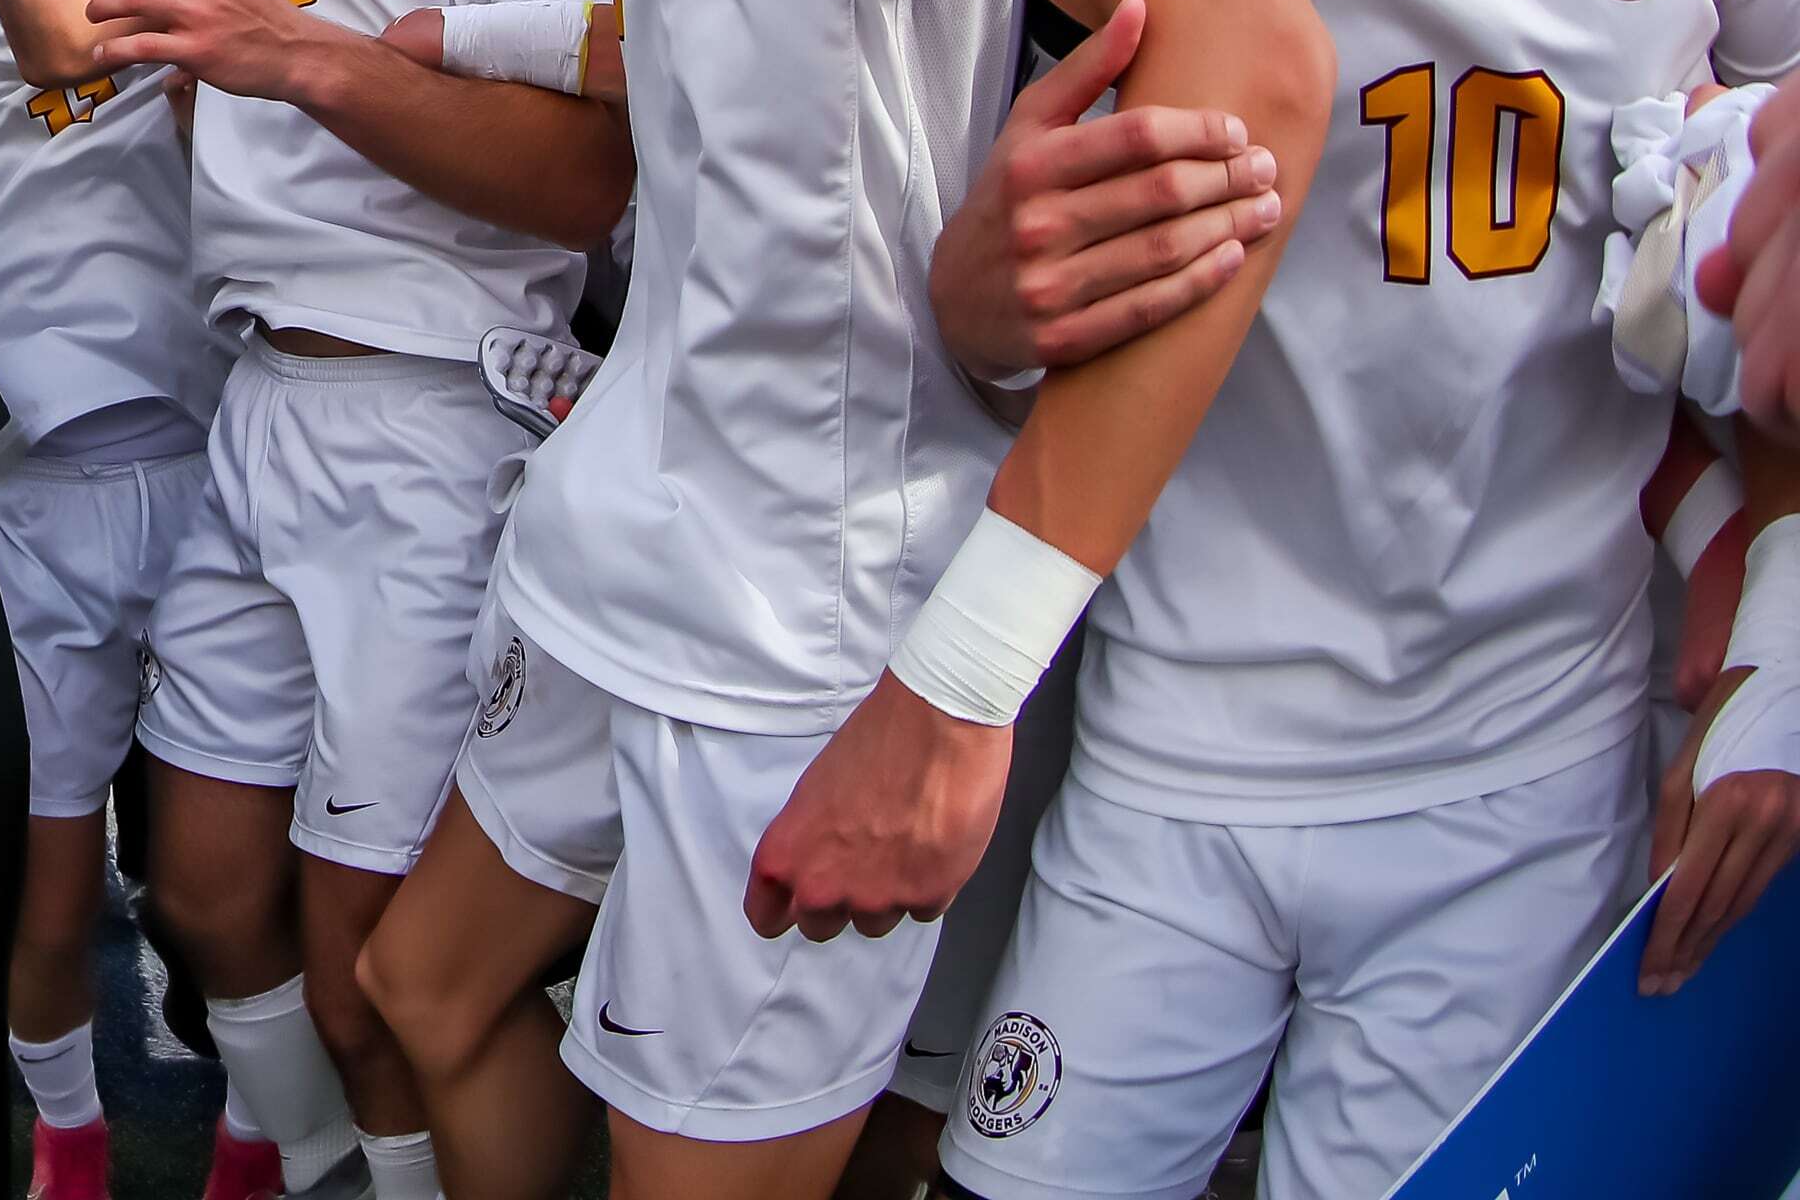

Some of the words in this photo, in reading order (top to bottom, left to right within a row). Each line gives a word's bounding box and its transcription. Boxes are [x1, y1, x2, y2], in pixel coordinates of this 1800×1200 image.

[1360, 62, 1565, 285] 10
[994, 1021, 1048, 1055] MADISON
[970, 1096, 1023, 1131] DODGERS
[1515, 1152, 1537, 1187] TM
